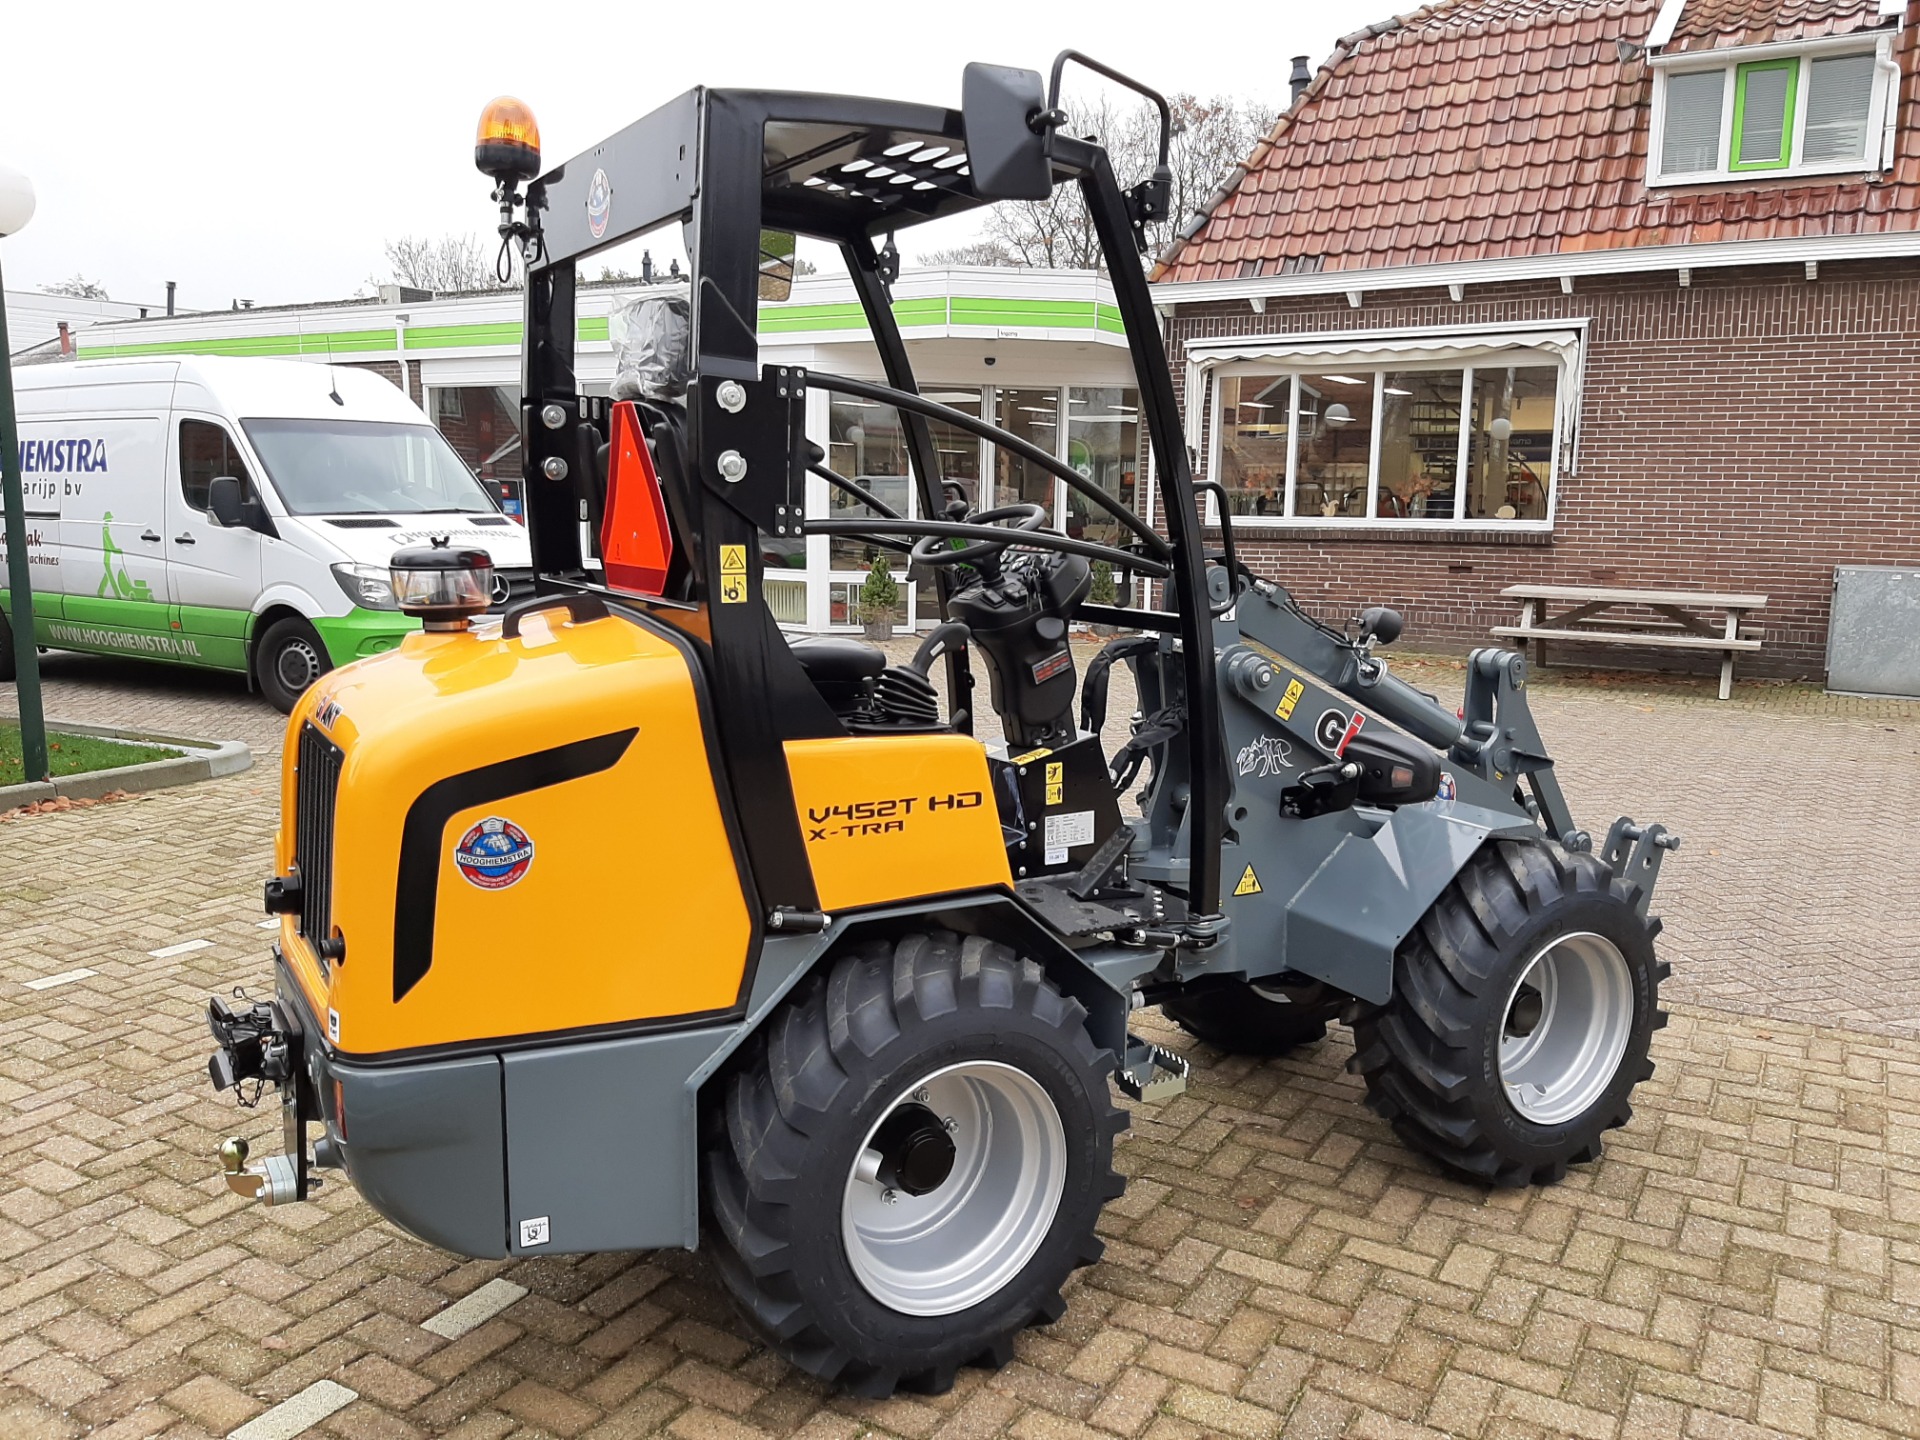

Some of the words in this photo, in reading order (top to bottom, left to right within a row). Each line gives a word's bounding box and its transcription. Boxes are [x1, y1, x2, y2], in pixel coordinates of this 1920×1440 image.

[23, 478, 56, 499] arijp
[48, 623, 202, 657] WWW.HOOGHIEMSTRA.NL
[808, 797, 918, 824] V452T
[928, 791, 983, 812] HD
[808, 820, 904, 842] X-TRA
[458, 848, 531, 866] HOOGHIEMSTRA
